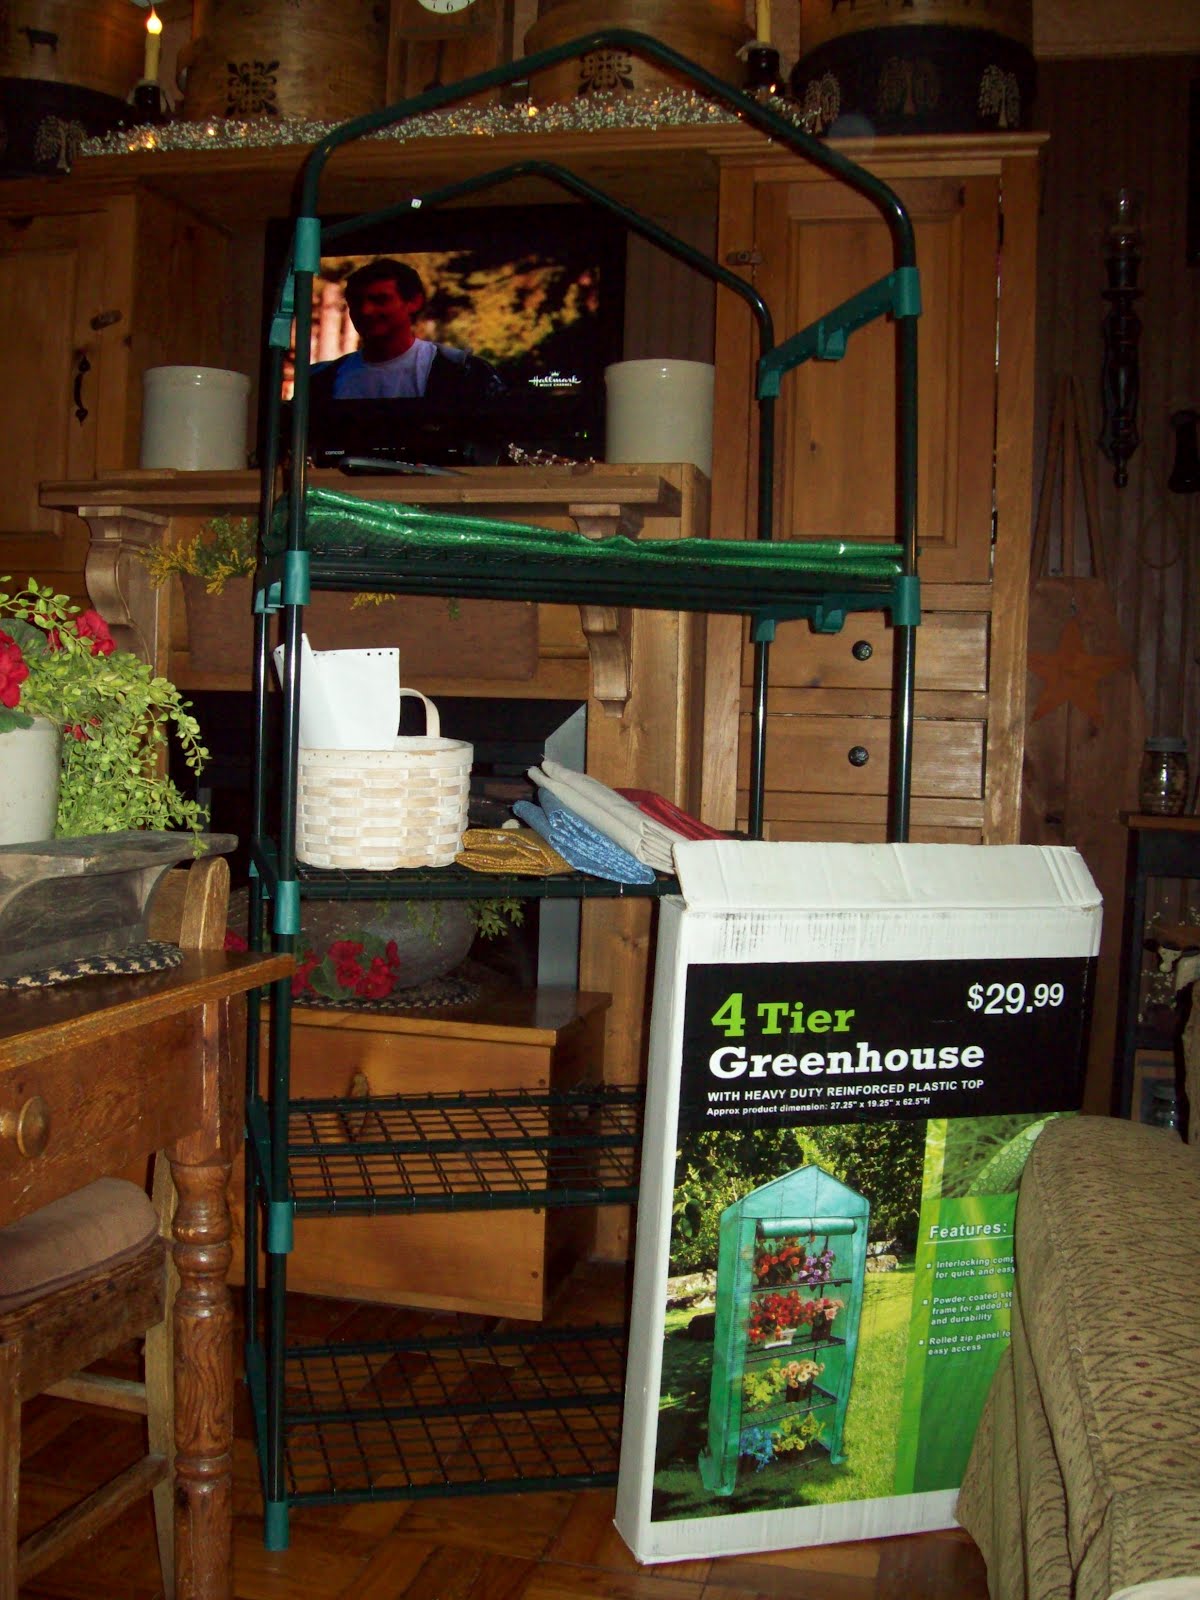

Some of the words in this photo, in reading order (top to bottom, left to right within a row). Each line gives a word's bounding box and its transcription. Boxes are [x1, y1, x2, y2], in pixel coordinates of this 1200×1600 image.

[446, 2, 454, 11] 6
[528, 375, 582, 387] Hallmark
[966, 982, 1065, 1014] $29.99
[710, 992, 746, 1037] 4
[756, 1001, 855, 1035] Tier
[708, 1041, 985, 1079] Greenhouse
[707, 1091, 740, 1102] WITH
[744, 1089, 787, 1100] HEAVY
[790, 1087, 823, 1098] DUTY
[826, 1084, 905, 1097] REINFORCED
[908, 1081, 957, 1093] PLASTIC
[961, 1079, 984, 1089] TOP
[706, 1107, 740, 1117] Approx
[742, 1105, 777, 1115] product
[779, 1103, 828, 1112] dimension:
[830, 1101, 857, 1110] 27.25"
[867, 1099, 893, 1108] 19.25"
[902, 1097, 930, 1106] 62.5"H
[929, 1223, 1007, 1239] Features:
[936, 1258, 990, 1269] Interlocking
[935, 1271, 948, 1279] for
[951, 1269, 975, 1279] quick
[978, 1267, 995, 1276] and
[997, 1266, 1016, 1274] easy
[933, 1295, 966, 1305] Powder
[968, 1292, 998, 1301] coated
[932, 1307, 957, 1315] frame
[960, 1305, 972, 1313] for
[975, 1301, 1002, 1311] added
[931, 1316, 948, 1326] and
[950, 1313, 992, 1323] durability
[929, 1335, 958, 1345] Rolled
[960, 1334, 973, 1342] zip
[975, 1330, 1000, 1341] panel
[928, 1347, 949, 1356] easy
[951, 1344, 982, 1353] access
